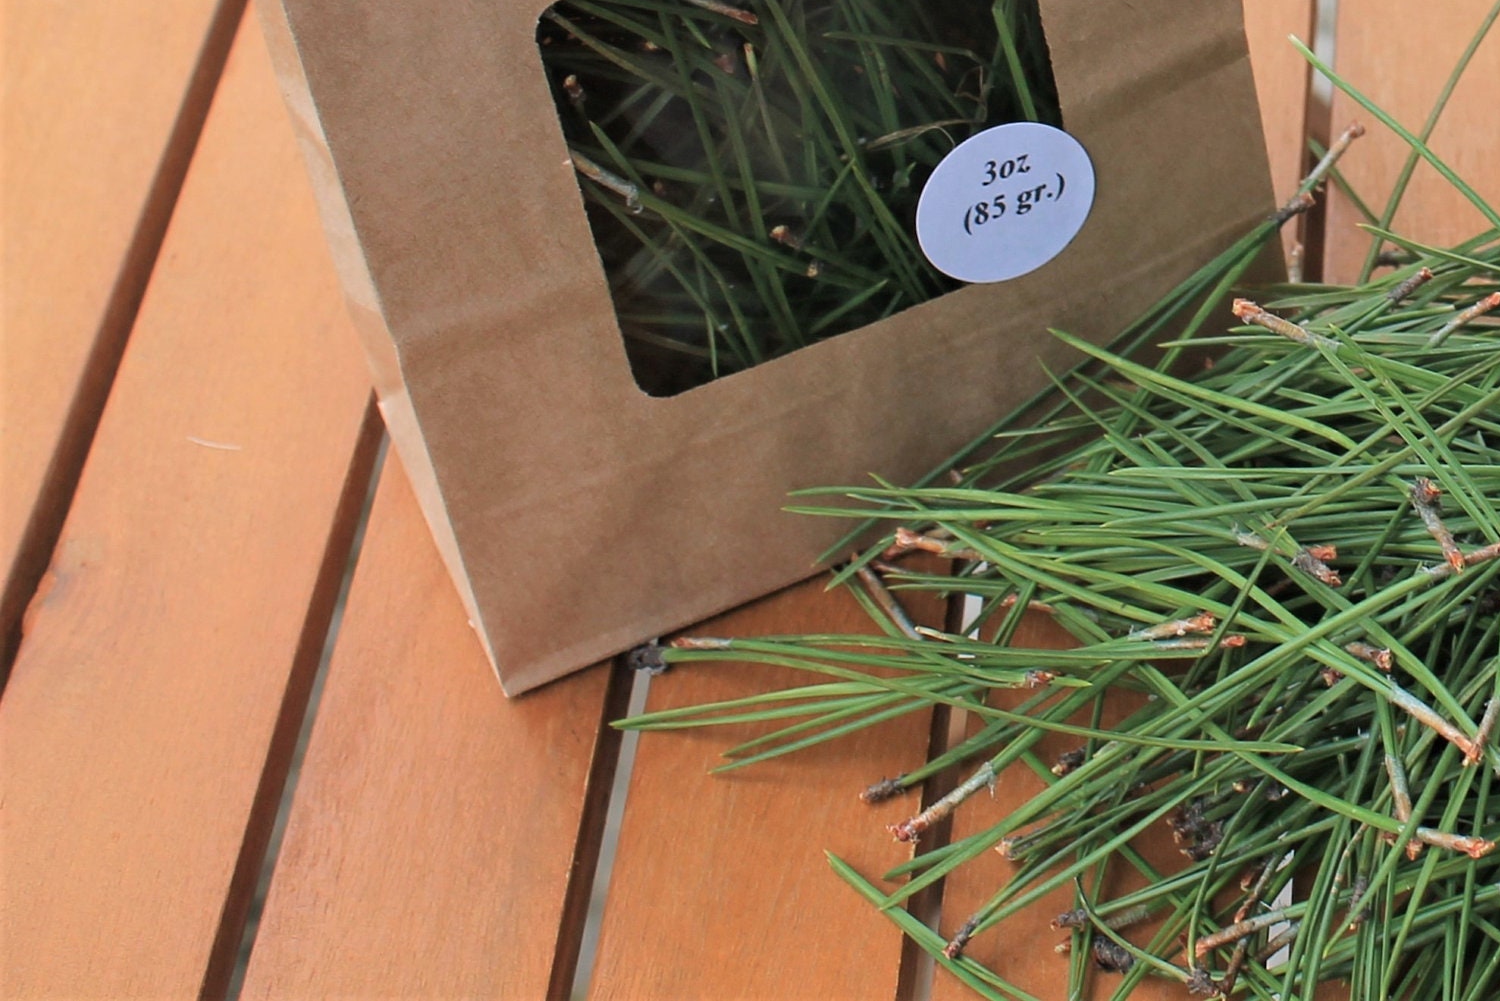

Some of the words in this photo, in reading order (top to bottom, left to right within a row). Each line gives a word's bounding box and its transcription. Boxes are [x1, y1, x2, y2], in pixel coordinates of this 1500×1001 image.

[981, 153, 1032, 187] 3oz
[963, 194, 1007, 236] (85
[1015, 172, 1066, 216] gr.)
